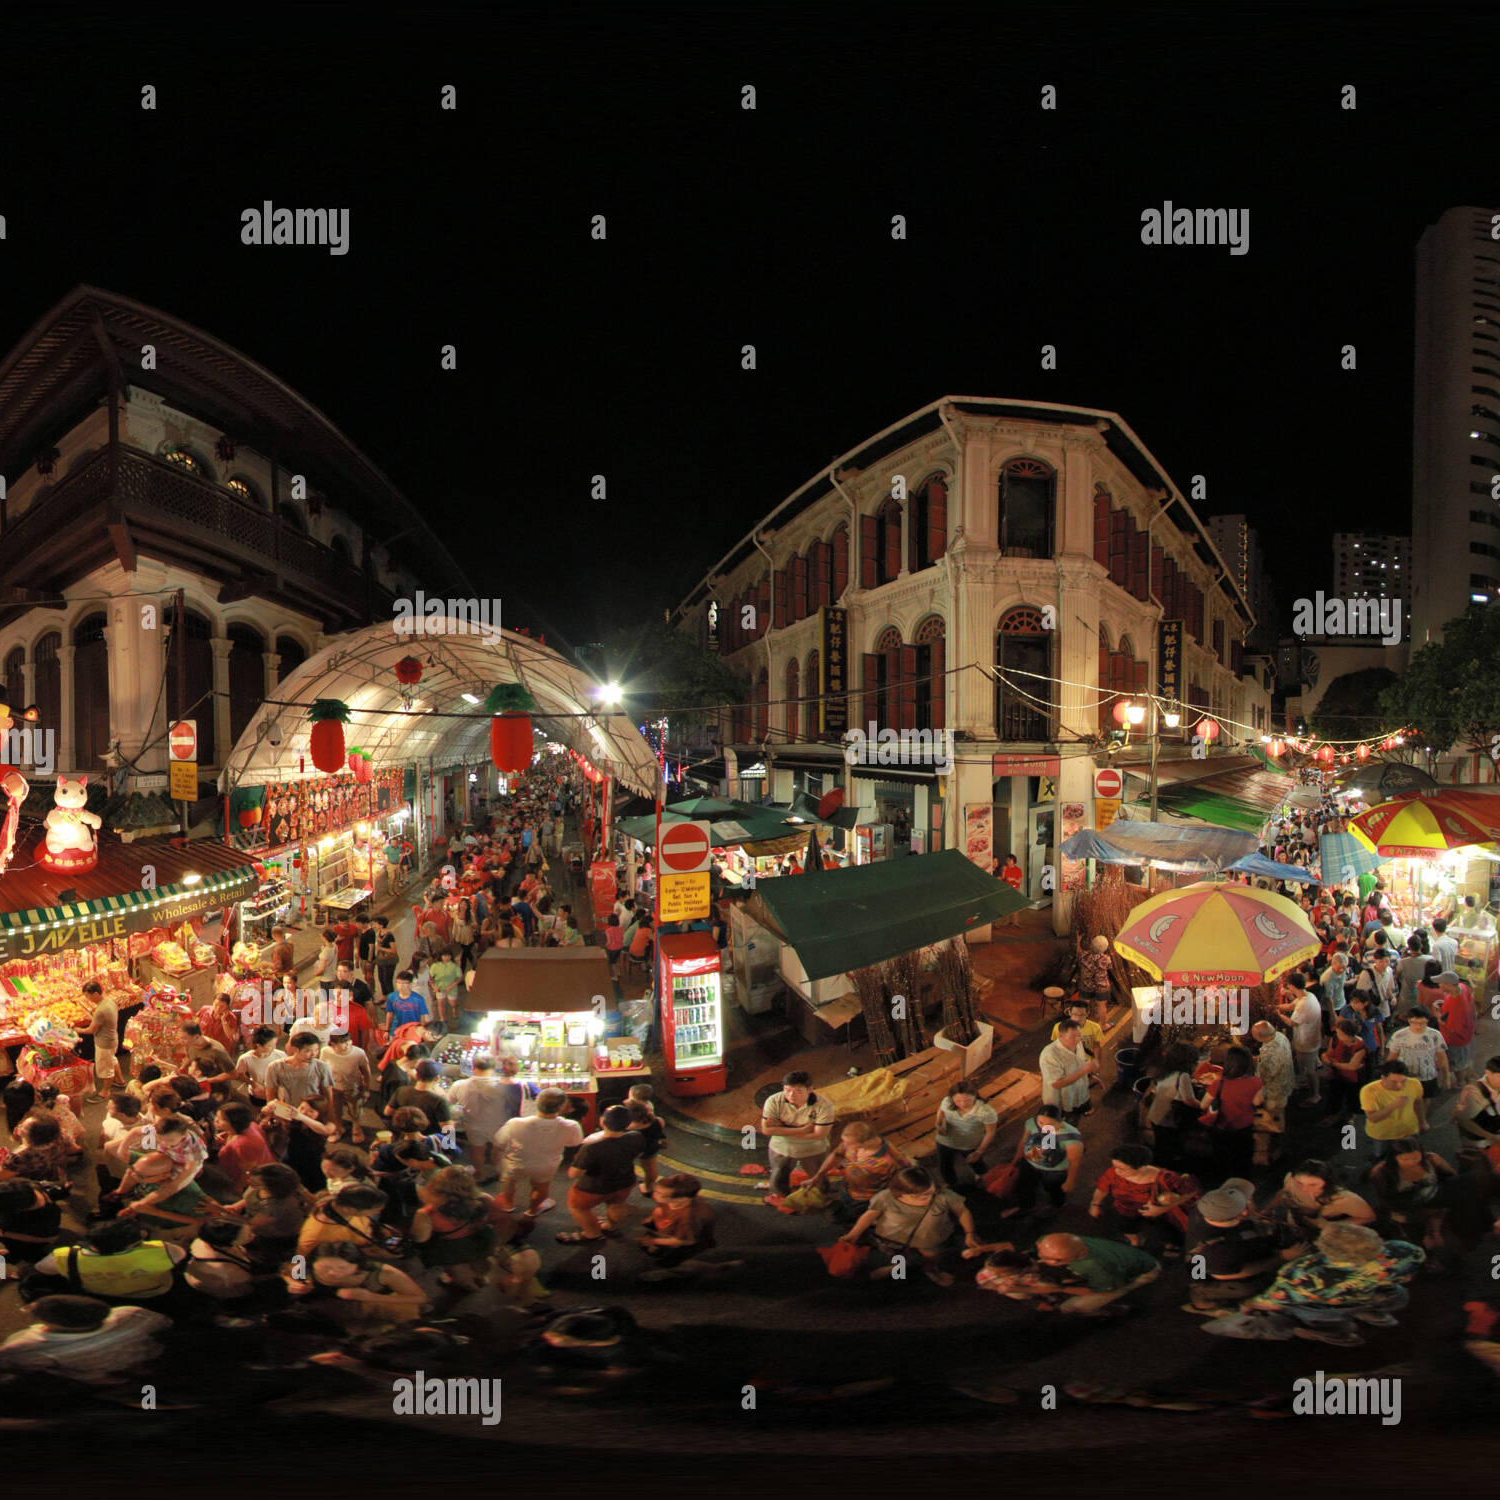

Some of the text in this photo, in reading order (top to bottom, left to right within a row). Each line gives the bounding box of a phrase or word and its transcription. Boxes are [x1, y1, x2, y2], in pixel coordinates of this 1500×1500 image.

[152, 886, 246, 922] Wholesale & Retail
